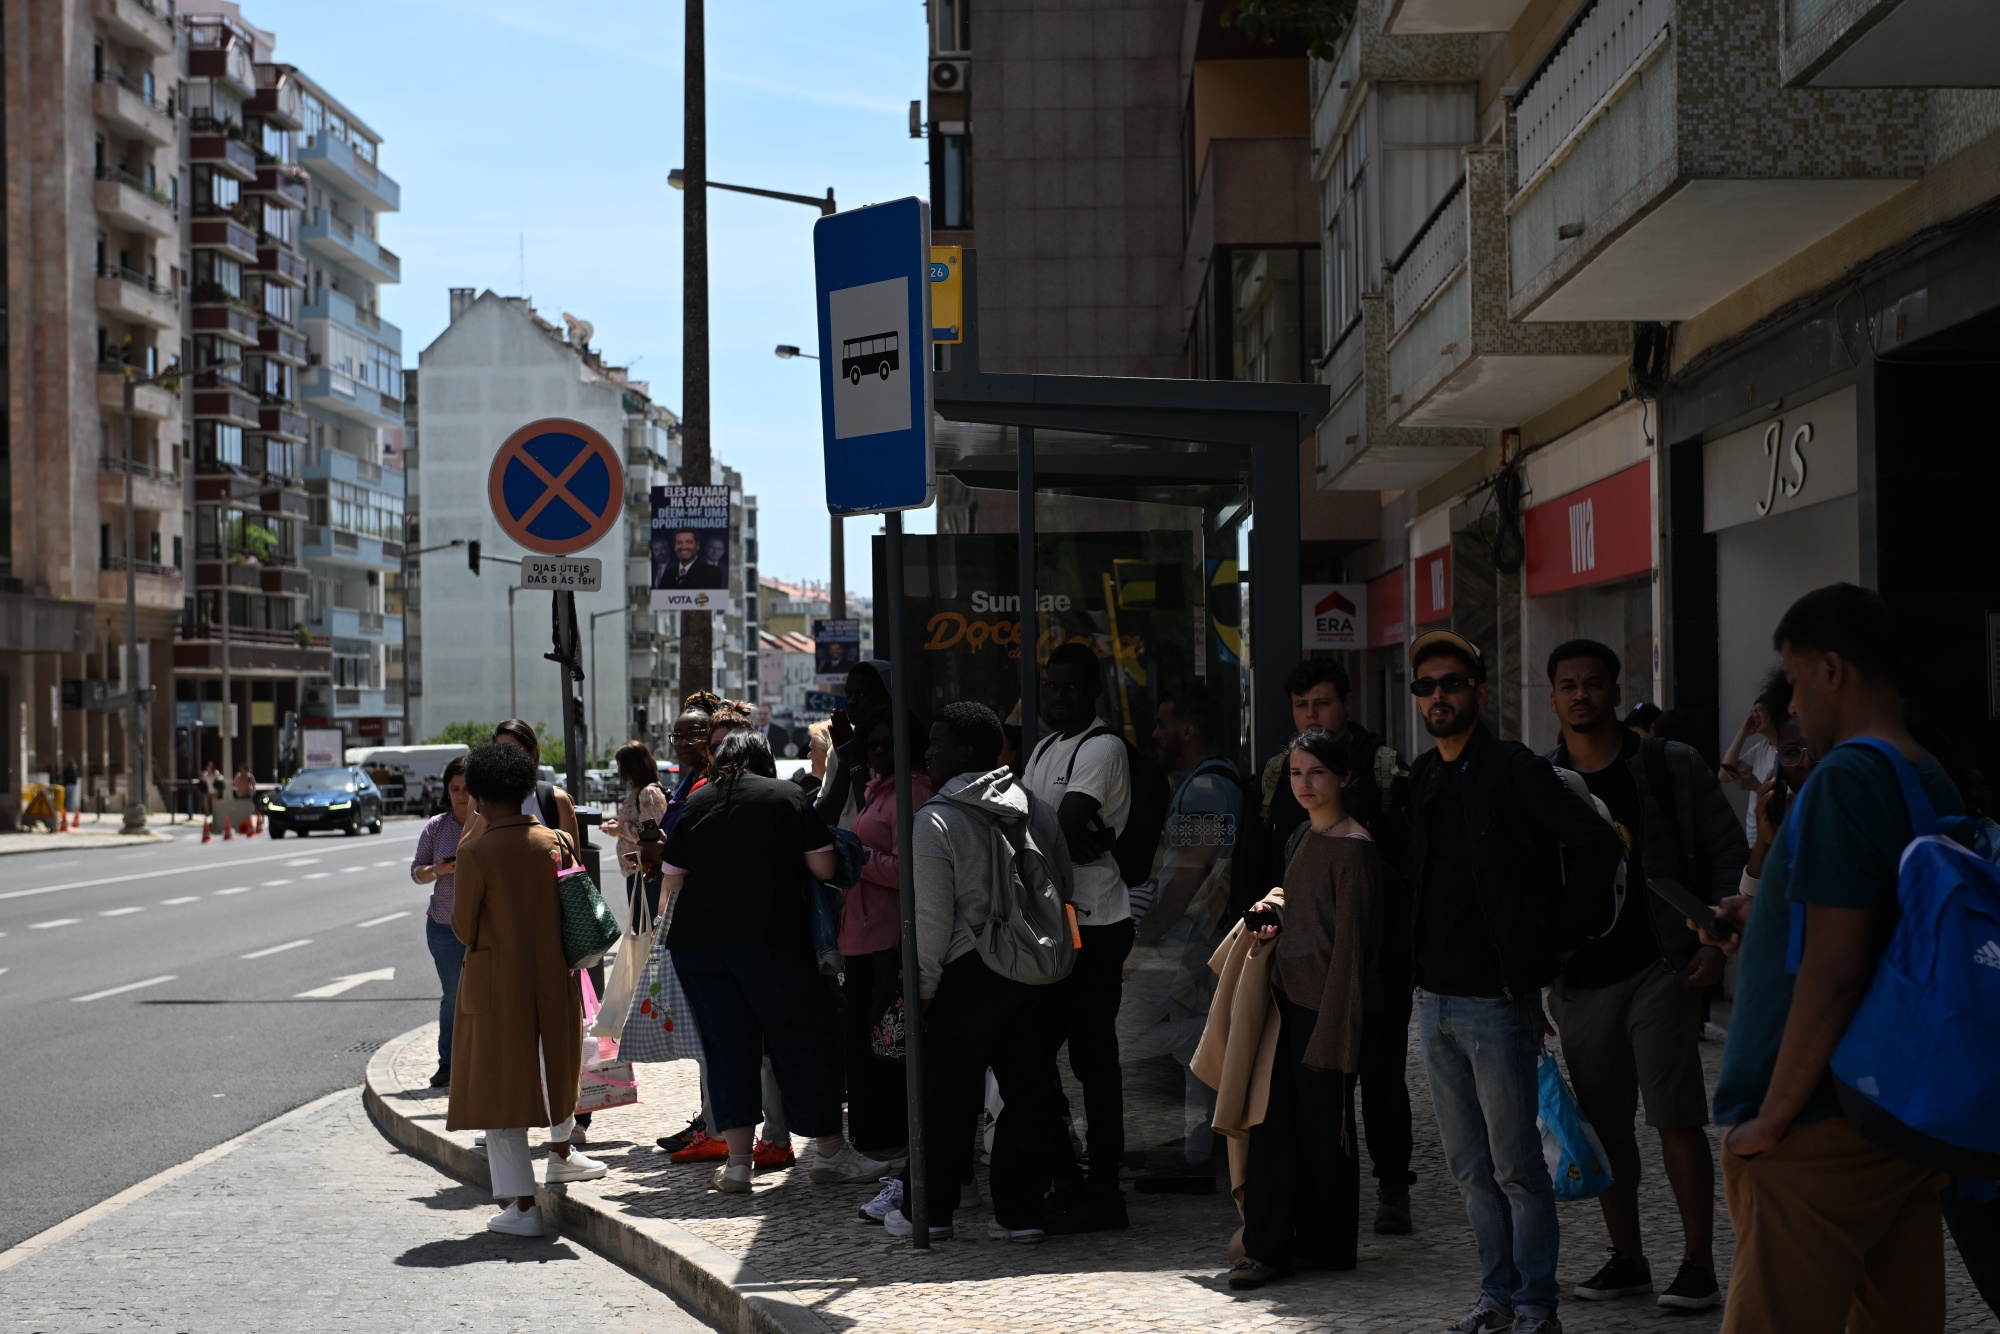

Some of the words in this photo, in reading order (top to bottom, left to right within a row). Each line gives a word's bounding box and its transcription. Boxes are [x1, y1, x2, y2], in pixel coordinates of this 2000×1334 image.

[664, 486, 686, 498] ELES
[687, 486, 728, 497] FALHAM
[685, 497, 700, 507] 50
[700, 497, 728, 507] ANOS
[704, 507, 728, 518] UMA
[652, 517, 728, 529] OPORTUNIDADE
[533, 564, 556, 572] DIAS
[560, 563, 590, 573] ÚTEIS
[528, 575, 547, 584] DAS
[551, 575, 557, 584] 8
[561, 574, 574, 584] ÀS
[578, 577, 595, 585] 19H
[668, 595, 692, 604] VOTA
[1317, 618, 1353, 631] ERA
